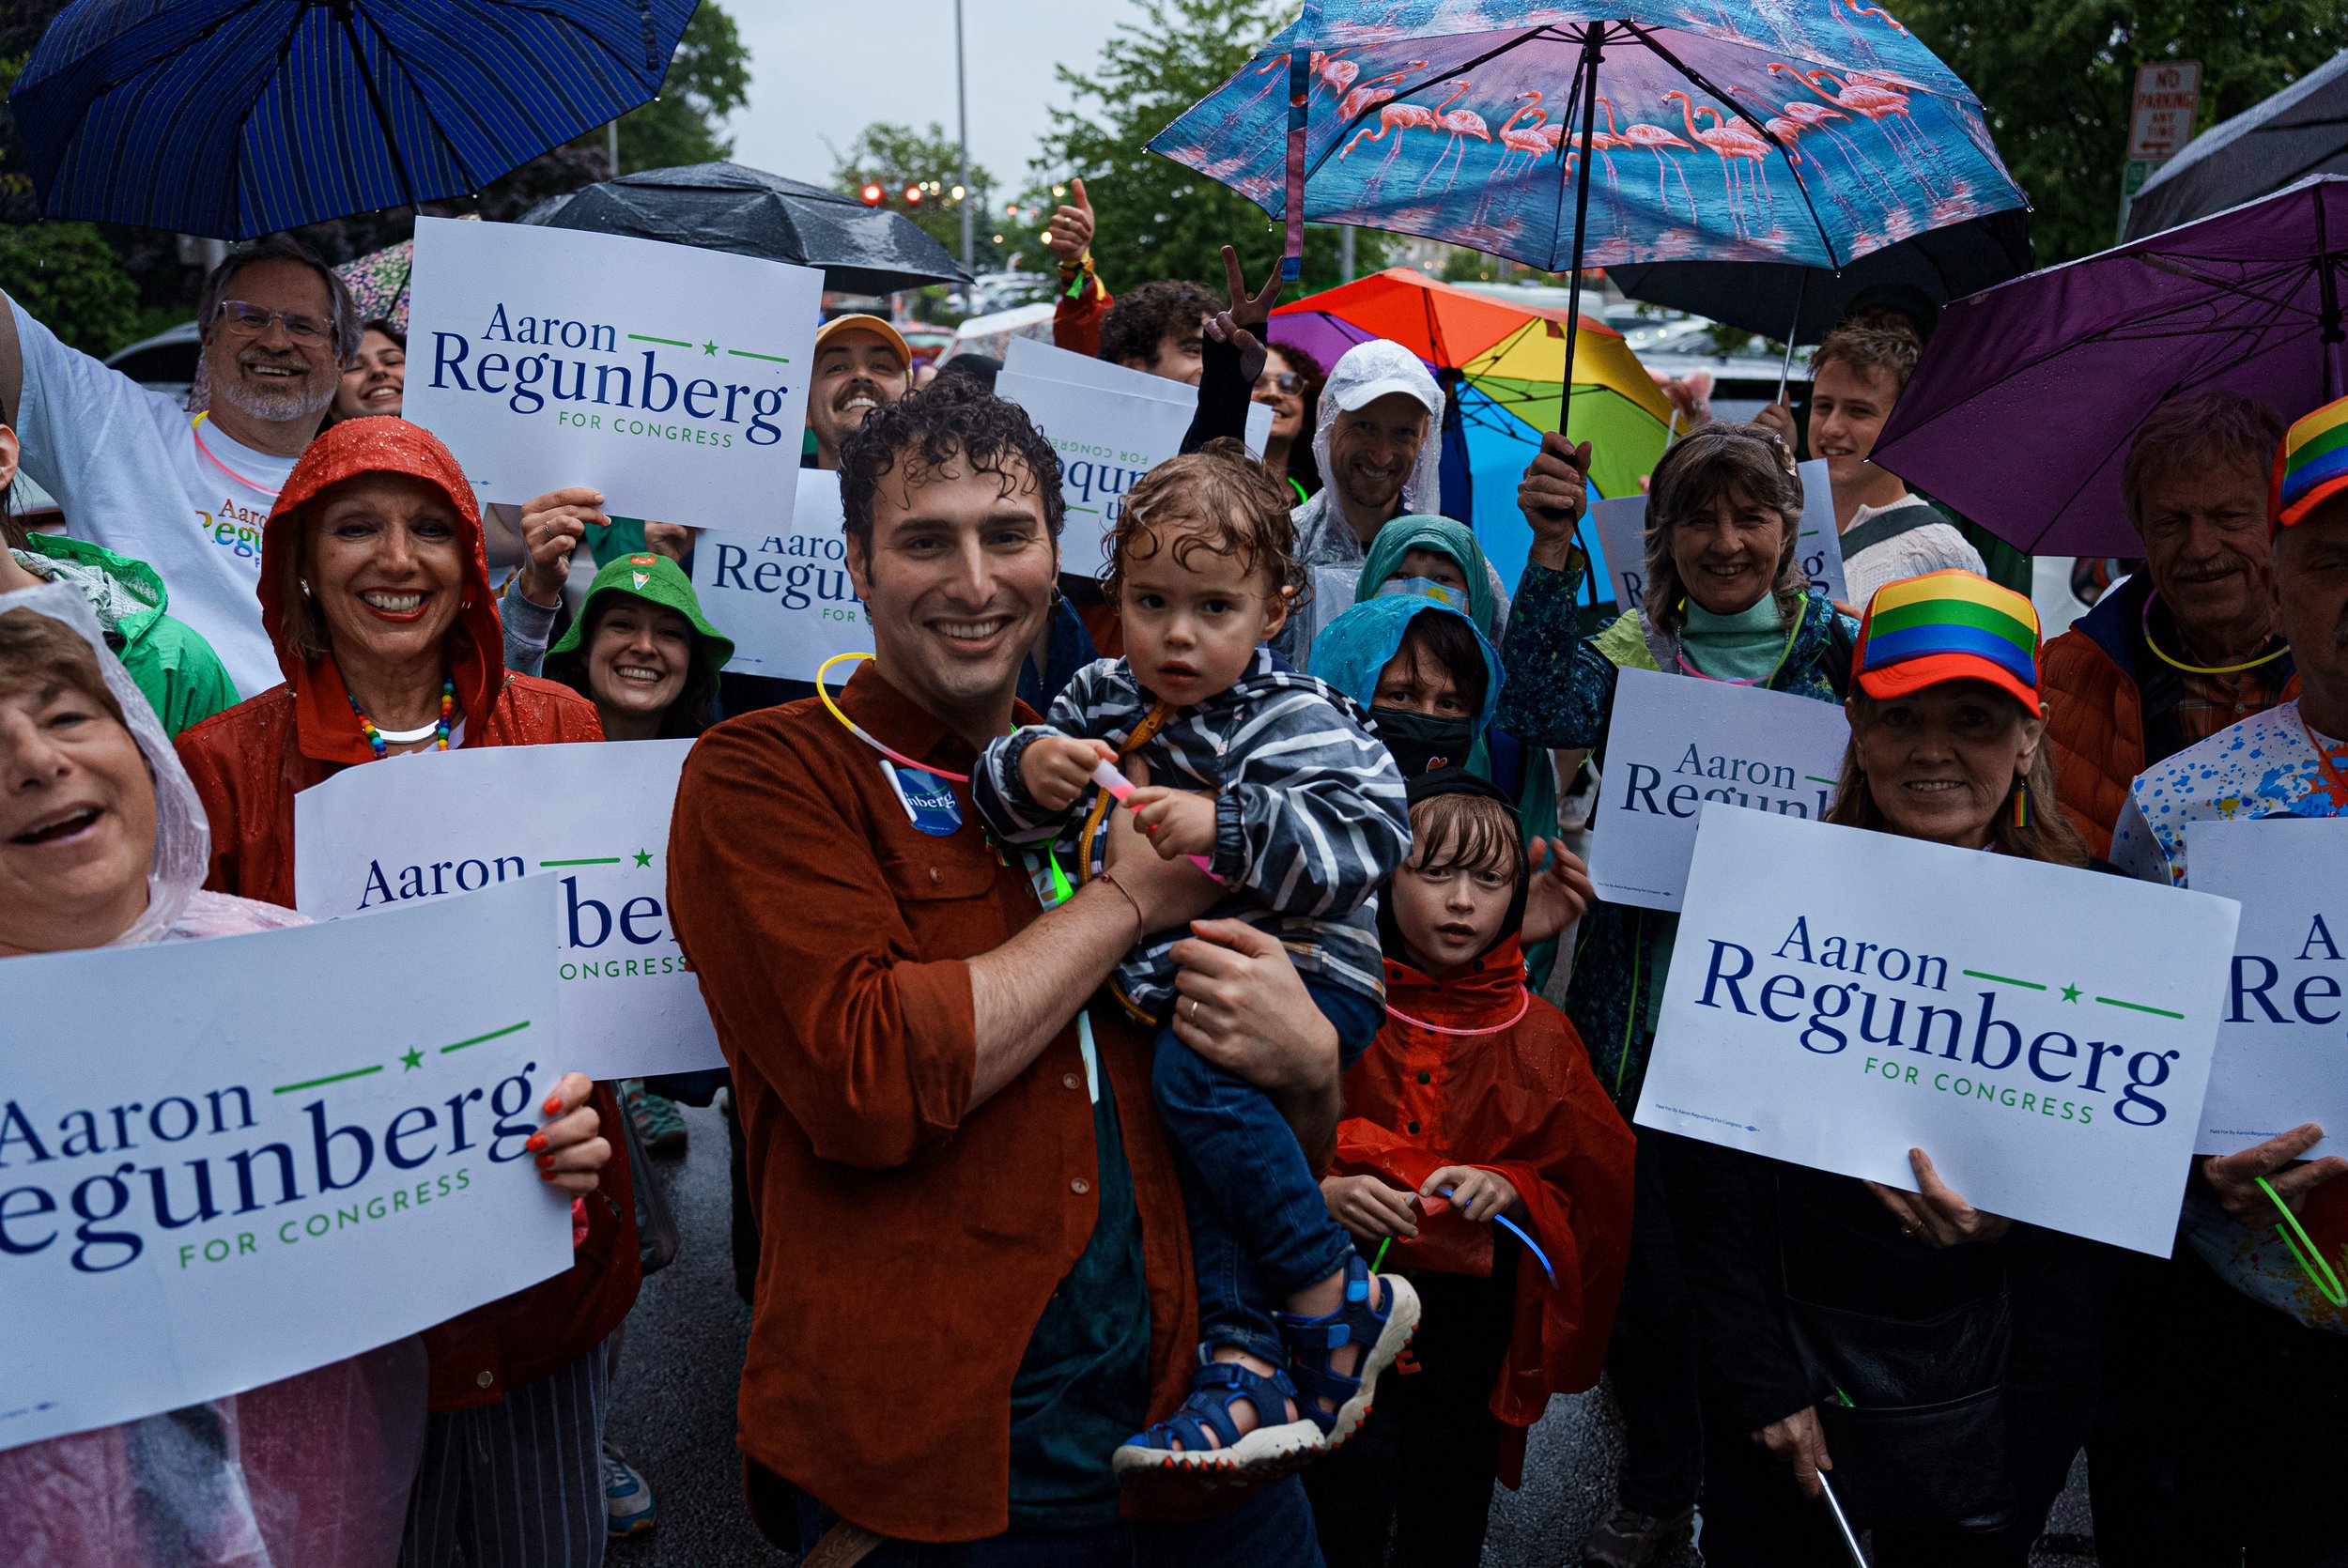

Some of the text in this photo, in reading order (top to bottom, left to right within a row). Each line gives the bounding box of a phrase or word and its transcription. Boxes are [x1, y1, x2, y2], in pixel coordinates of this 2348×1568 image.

[481, 302, 618, 353] Aaron
[428, 331, 788, 446] Regunberg
[558, 410, 734, 449] FOR CONGRESS
[711, 543, 862, 610] Regu
[822, 607, 857, 623] FOR
[1673, 743, 1797, 791] Aaron
[356, 853, 527, 911] Aaron
[1771, 915, 1949, 992] Aaron
[1694, 938, 2181, 1127] Regunberg
[1864, 1056, 2094, 1125] FOR CONGRESS
[0, 1084, 259, 1170] Aaron
[178, 1167, 471, 1270] FOR CONGRESS
